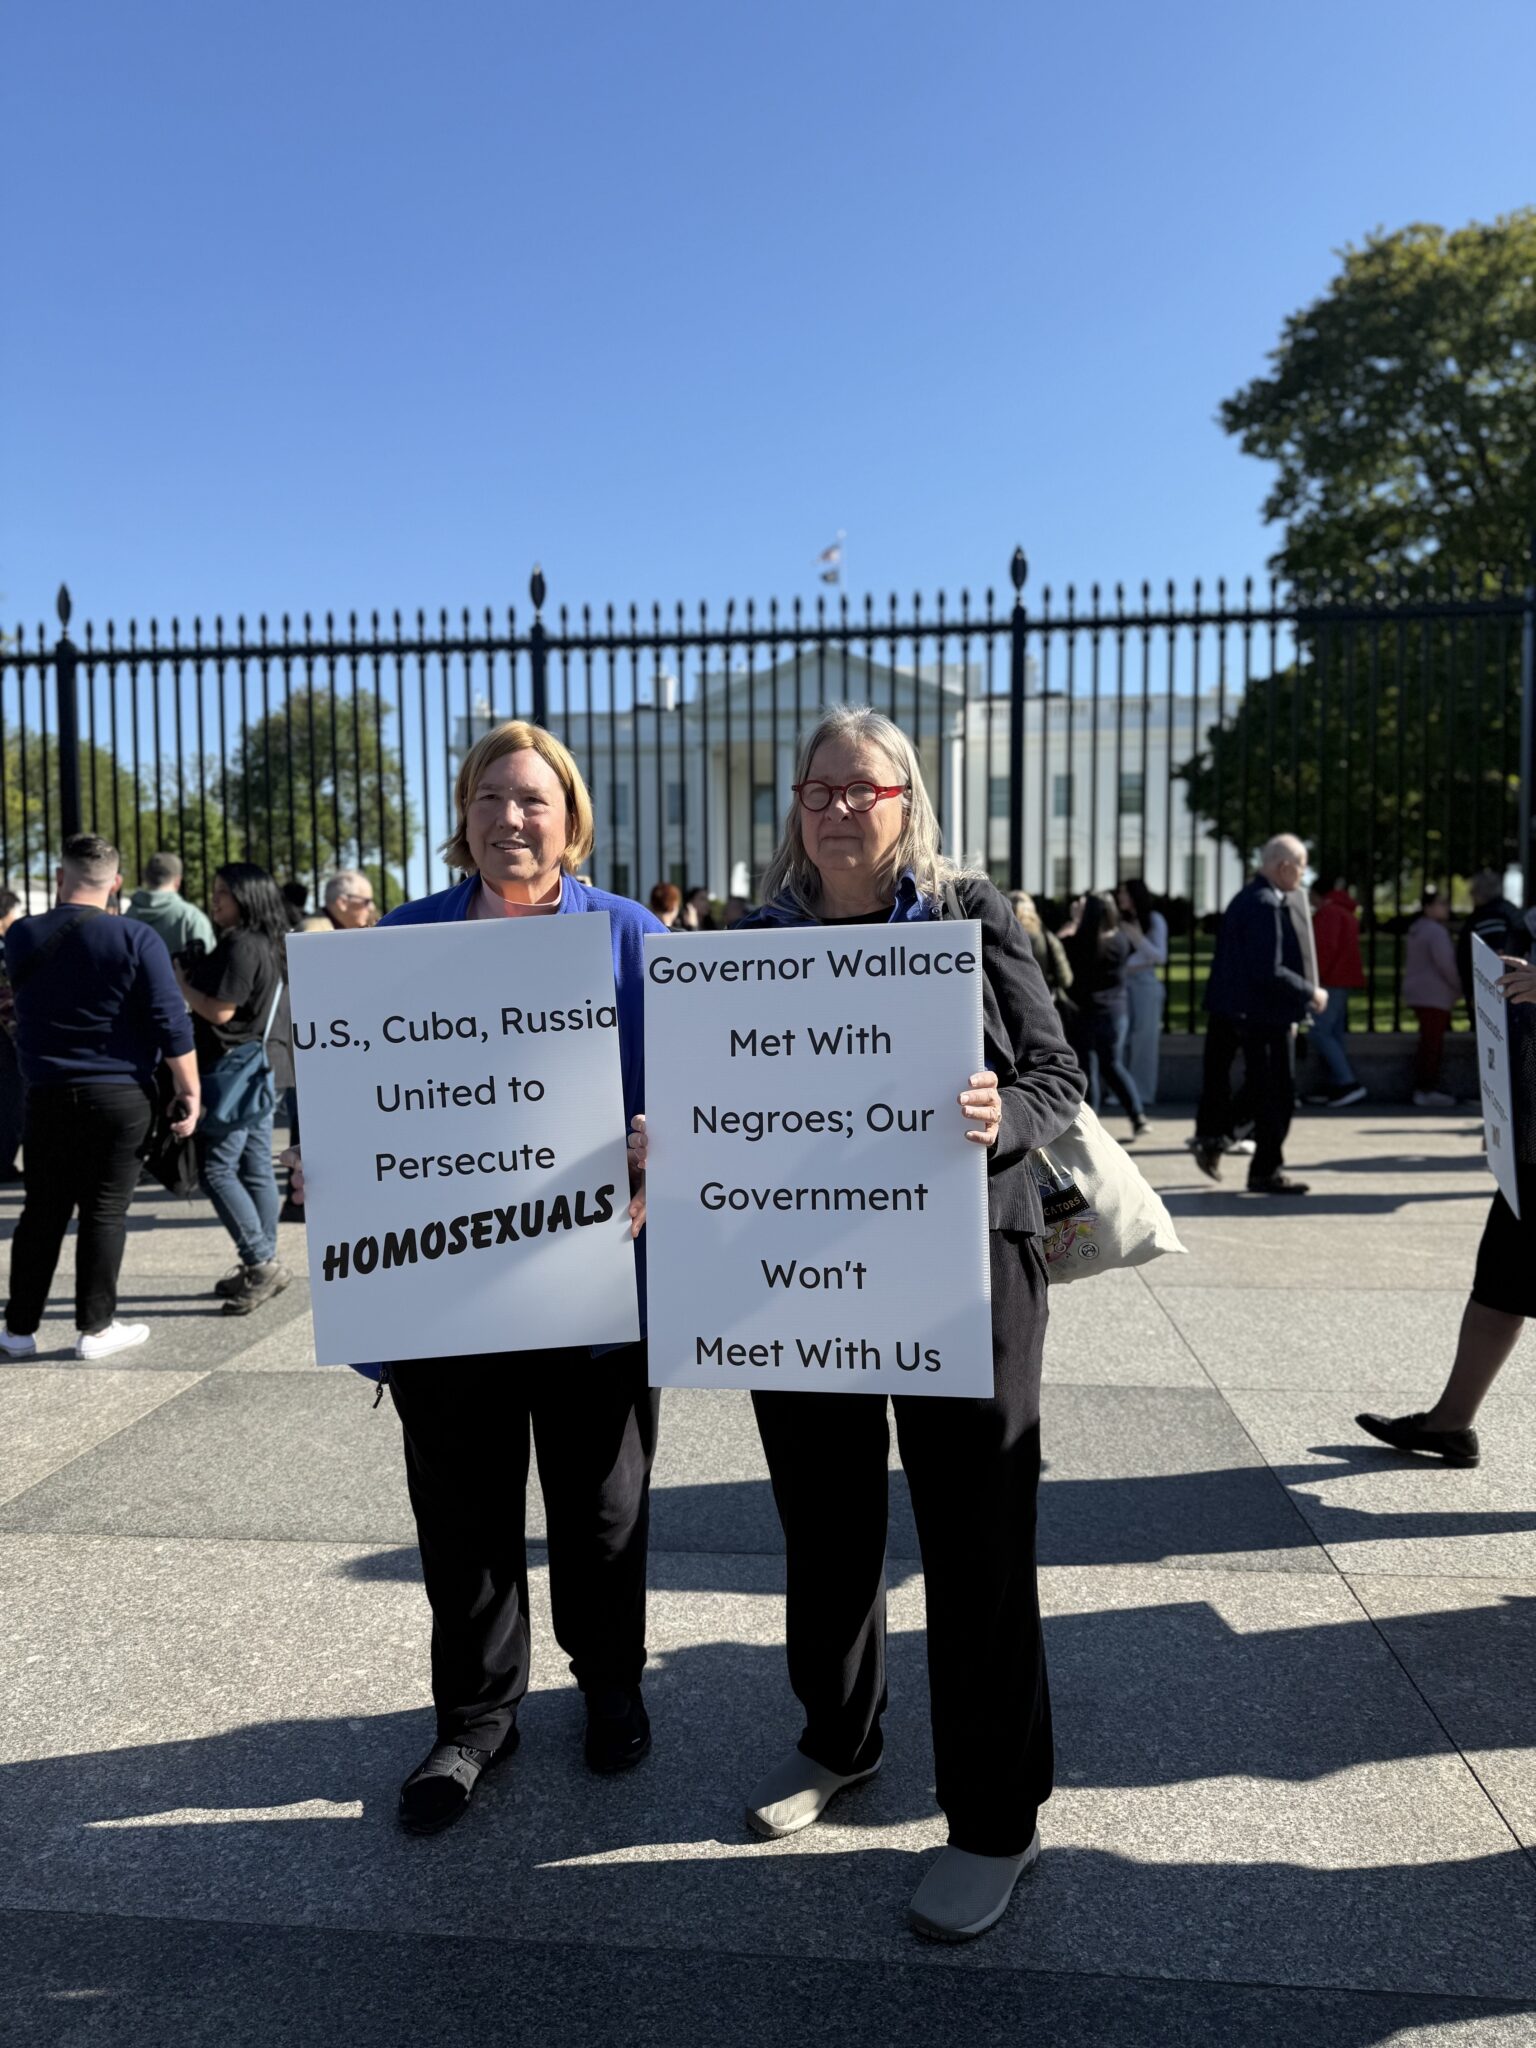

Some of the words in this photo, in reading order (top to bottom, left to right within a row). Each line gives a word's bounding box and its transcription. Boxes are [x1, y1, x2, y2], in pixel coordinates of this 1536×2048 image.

[649, 957, 815, 984] Governor
[827, 946, 975, 977] Wallace
[293, 1020, 370, 1054] U.S.,
[383, 1012, 488, 1043] Cuba,
[502, 997, 617, 1035] Russia
[731, 1029, 795, 1057] Met
[808, 1024, 890, 1055] With
[377, 1076, 495, 1112] United
[508, 1077, 544, 1102] to
[694, 1106, 853, 1141] Negroes;
[867, 1103, 934, 1132] Our
[376, 1145, 555, 1181] Persecute
[701, 1182, 928, 1210] Government
[323, 1184, 614, 1281] HOMOSEXUALS
[761, 1260, 866, 1289] Won't
[697, 1337, 783, 1367] Meet
[796, 1338, 880, 1370] With
[896, 1342, 941, 1372] Us
